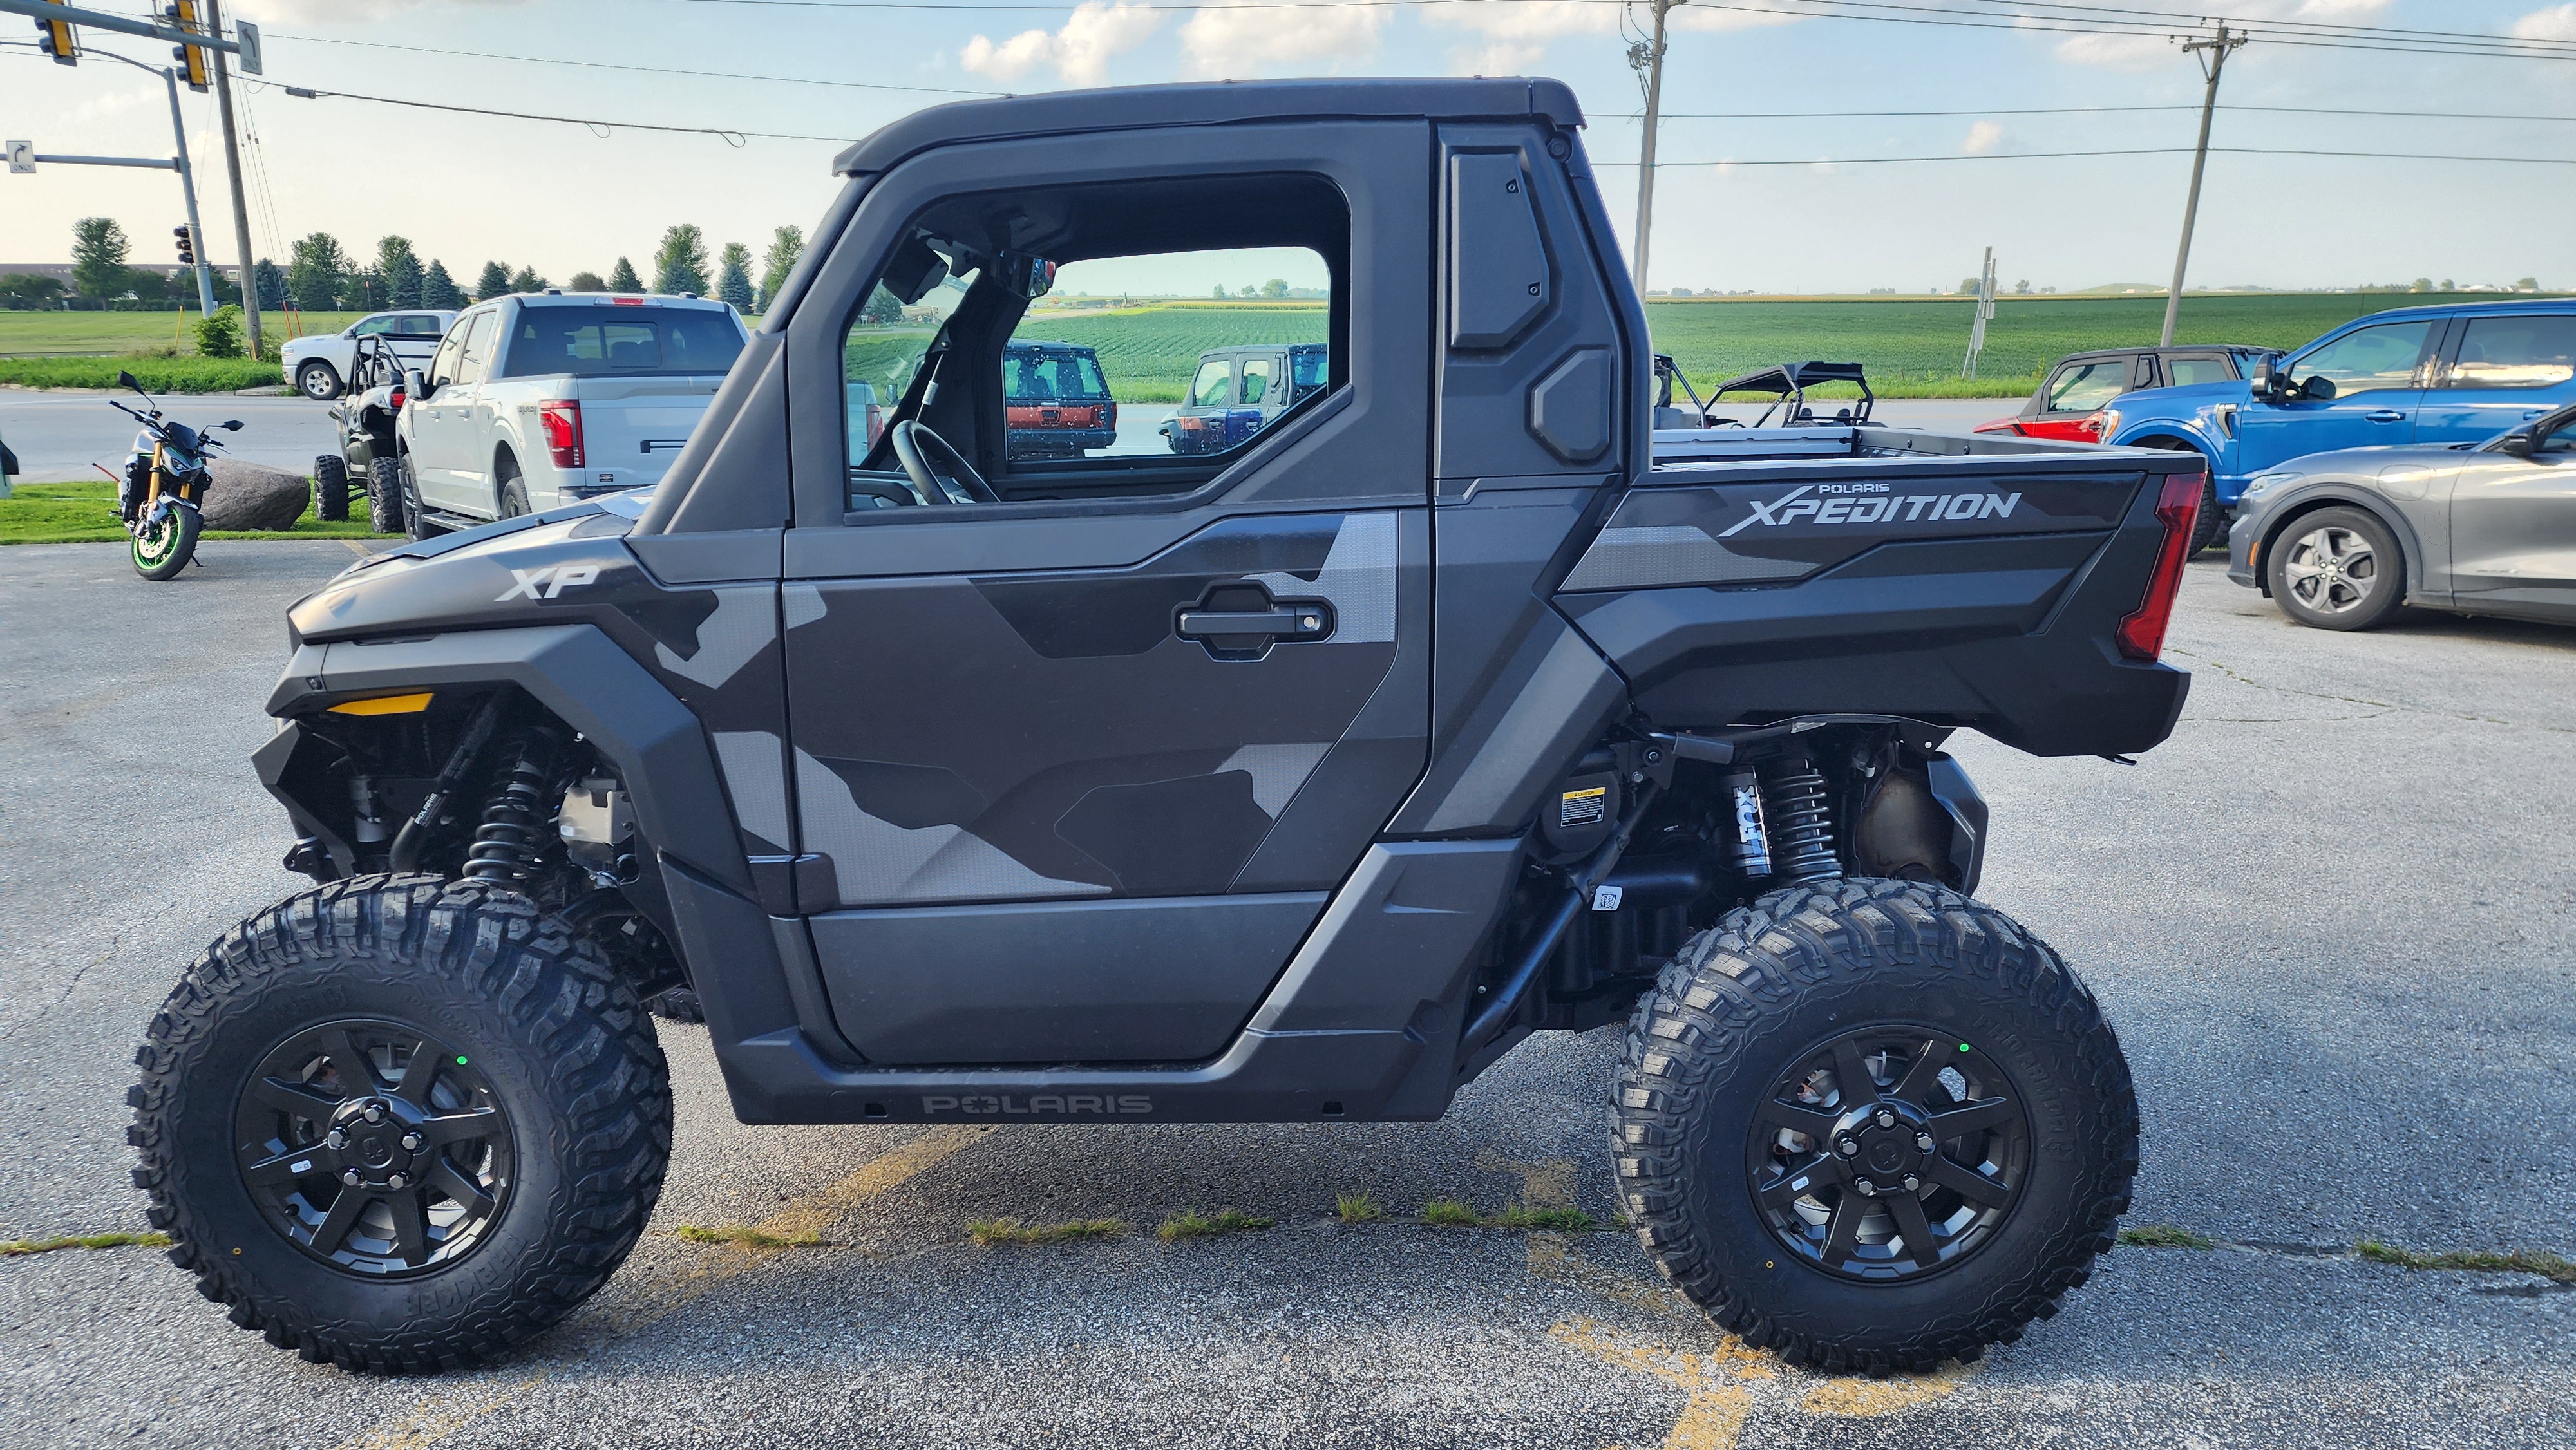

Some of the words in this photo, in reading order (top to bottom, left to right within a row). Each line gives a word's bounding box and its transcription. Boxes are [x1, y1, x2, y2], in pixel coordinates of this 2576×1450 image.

[1819, 483, 1891, 494] POLARIS
[1718, 485, 2022, 538] XPEDITION
[493, 565, 601, 602] XP
[414, 793, 437, 824] POLARIS
[1733, 785, 1763, 843] FOX
[923, 1095, 1153, 1115] POLARIS
[402, 1235, 527, 1317] TREKKER
